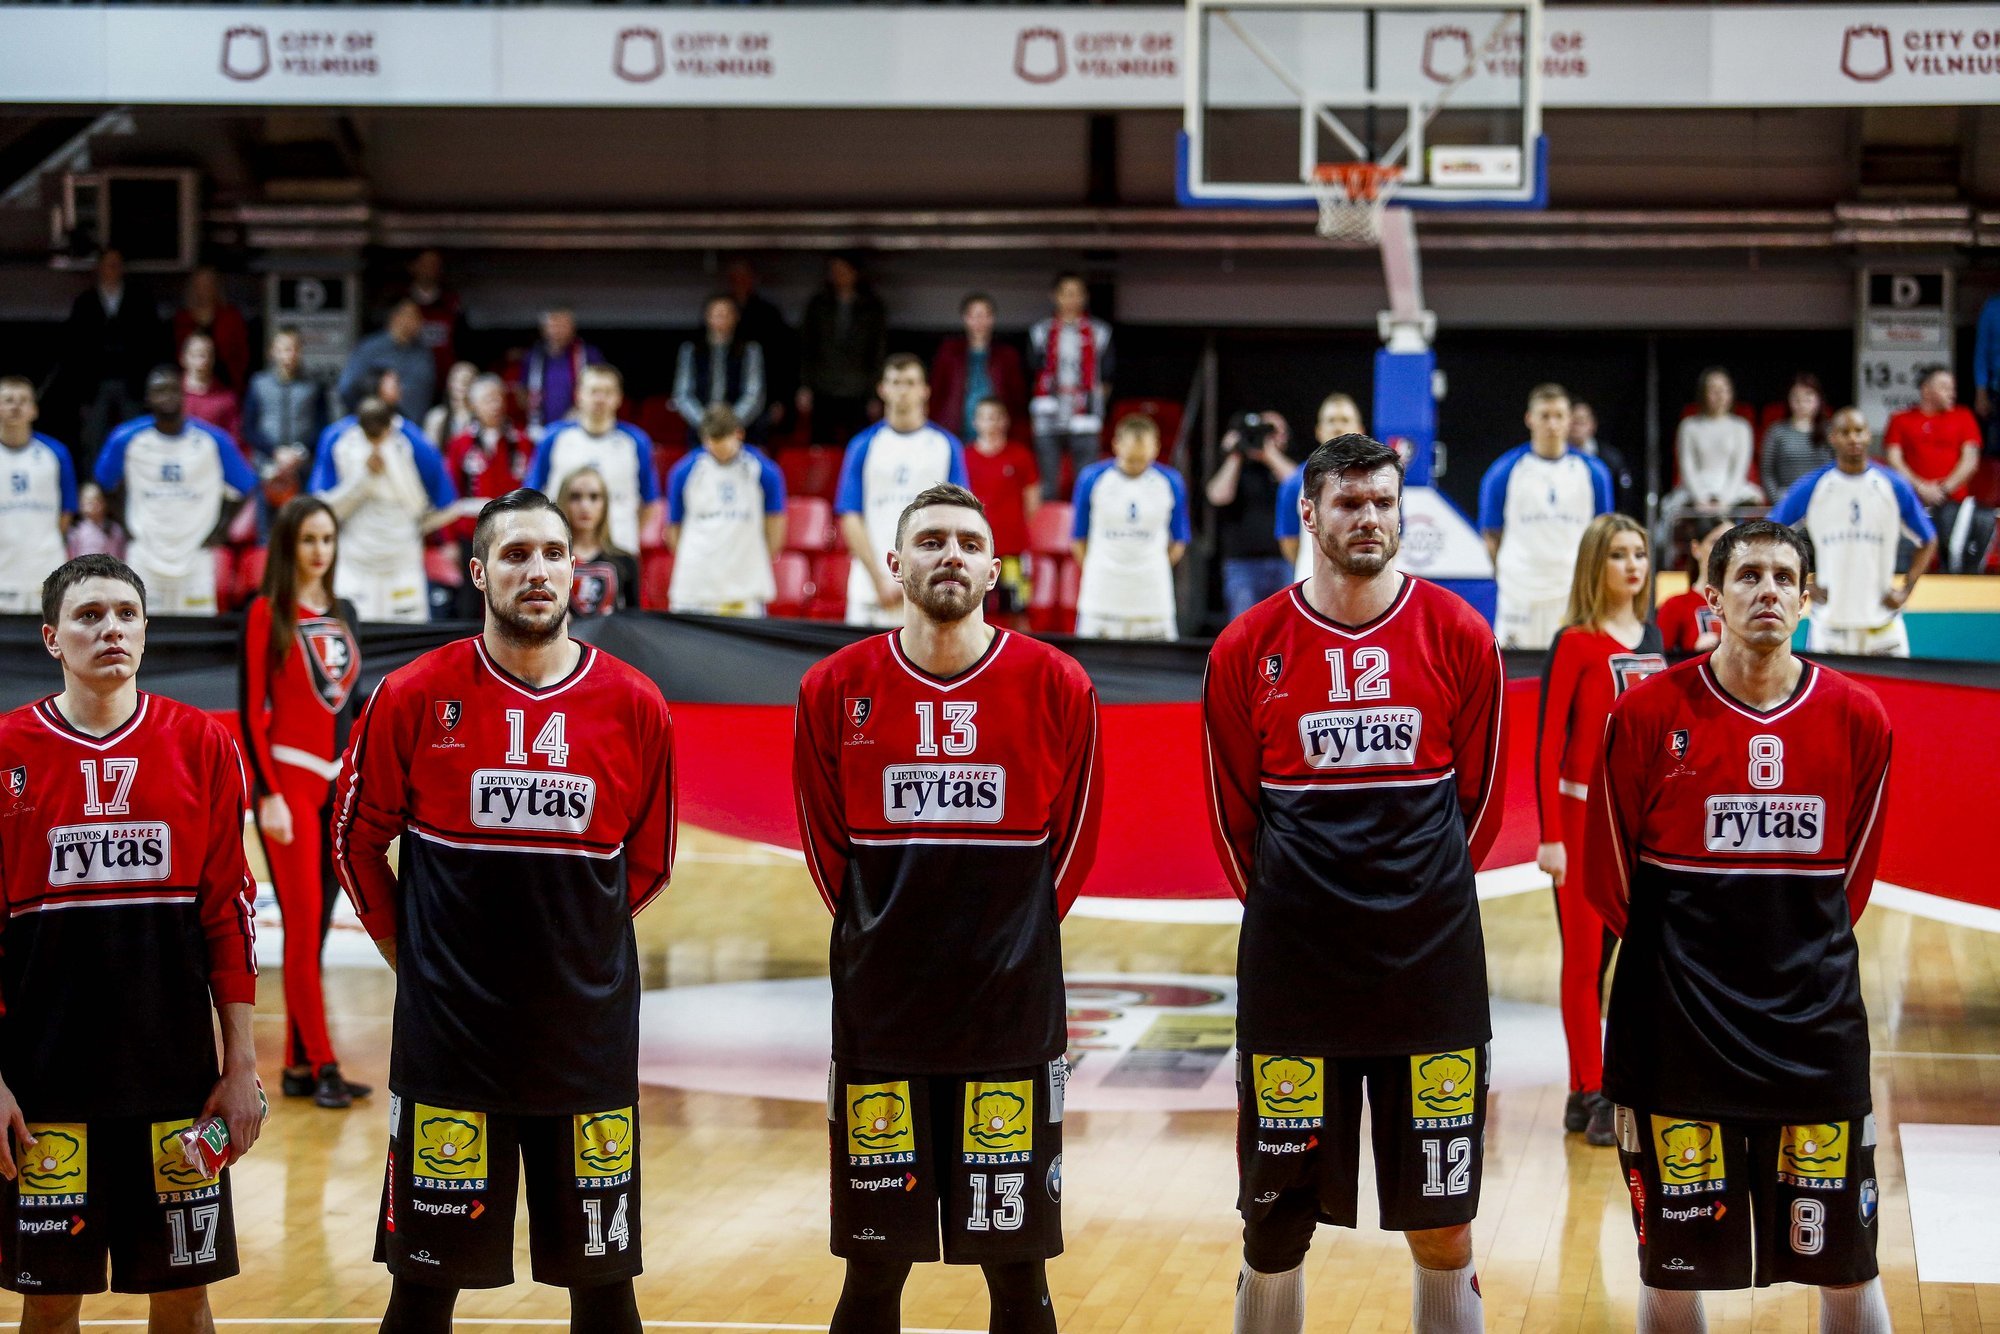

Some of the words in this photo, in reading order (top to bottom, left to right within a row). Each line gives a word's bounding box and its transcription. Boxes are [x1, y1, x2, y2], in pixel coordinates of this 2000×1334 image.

[278, 32, 335, 51] CITY
[343, 32, 374, 51] OF
[673, 32, 730, 52] CITY
[739, 32, 769, 52] OF
[1074, 31, 1133, 53] CITY
[1141, 31, 1174, 53] OF
[1549, 31, 1584, 52] OF
[1904, 30, 1962, 50] CITY
[279, 57, 377, 75] VILNIUS
[674, 58, 774, 77] VILNIUS
[1075, 58, 1176, 77] VILNIUS
[1892, 276, 1920, 307] D
[1325, 646, 1390, 702] 12
[915, 702, 977, 756] 13
[1307, 717, 1354, 729] LIETUVOS
[1366, 714, 1414, 724] BASKET
[505, 708, 569, 767] 14
[1307, 716, 1413, 762] rytas
[1748, 734, 1783, 789] 8
[480, 776, 529, 787] LIETUVOS
[540, 778, 588, 792] BASKET
[891, 771, 938, 780] LIETUVOS
[949, 771, 997, 780] BASKET
[80, 757, 138, 815] 17
[891, 771, 997, 816] rytas
[478, 778, 587, 823] rytas
[1713, 801, 1758, 811] LIETUVOS
[1770, 802, 1817, 811] BASKET
[1711, 801, 1817, 847] rytas
[55, 830, 101, 843] LIETUVOS
[113, 828, 162, 838] BASKET
[54, 830, 163, 878] rytas
[1259, 1117, 1322, 1128] PERLAS
[1415, 1115, 1473, 1129] PERLAS
[1258, 1141, 1306, 1155] TonyBet
[850, 1152, 914, 1165] PERLAS
[964, 1152, 1030, 1164] PERLAS
[1422, 1137, 1471, 1197] 12
[413, 1176, 485, 1190] PERLAS
[577, 1171, 632, 1188] PERLAS
[850, 1177, 903, 1191] TonyBet
[1662, 1179, 1724, 1196] PERLAS
[1777, 1172, 1843, 1189] PERLAS
[19, 1194, 85, 1206] PERLAS
[158, 1184, 220, 1204] PERLAS
[967, 1173, 1025, 1231] 13
[412, 1199, 467, 1216] TonyBet
[1662, 1205, 1713, 1222] TonyBet
[582, 1193, 630, 1257] 14
[1789, 1198, 1824, 1255] 8
[166, 1203, 220, 1267] 17
[410, 1254, 440, 1265] AUDIMAS
